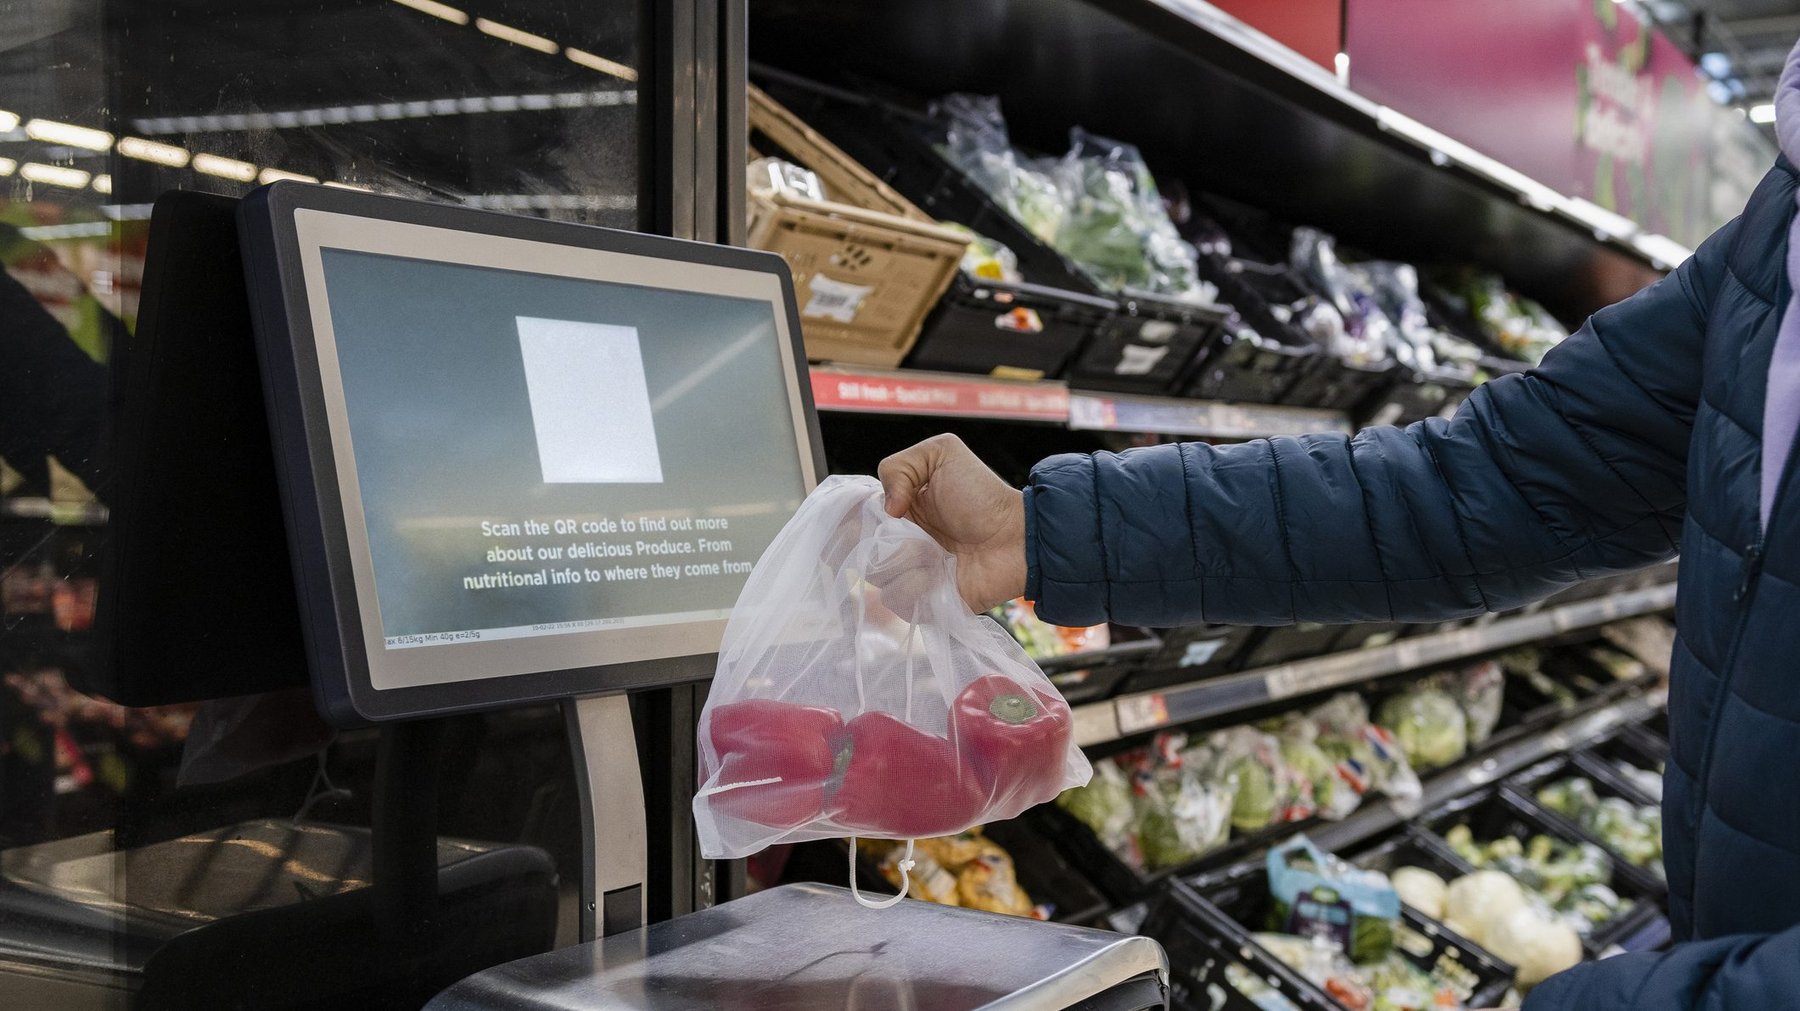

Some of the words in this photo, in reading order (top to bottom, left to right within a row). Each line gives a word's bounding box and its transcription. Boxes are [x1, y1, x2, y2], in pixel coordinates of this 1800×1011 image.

[481, 521, 520, 536] Scan
[524, 520, 550, 535] the
[554, 519, 578, 534] QR
[581, 517, 617, 534] code
[621, 518, 636, 532] to
[639, 517, 667, 532] find
[670, 517, 692, 531] out
[695, 518, 728, 530] more
[486, 545, 534, 562] about
[537, 547, 563, 560] our
[567, 542, 633, 559] delicious
[635, 540, 696, 556] Produce.
[698, 538, 732, 553] From
[463, 570, 548, 589] nutritional
[550, 567, 581, 584] info
[584, 567, 600, 582] to
[604, 565, 648, 581] where
[651, 563, 680, 580] they
[684, 564, 720, 576] come
[722, 560, 752, 574] from
[384, 638, 396, 646] ax
[425, 634, 439, 642] Min
[440, 632, 454, 641] 40g
[455, 631, 480, 640] e=2/5g
